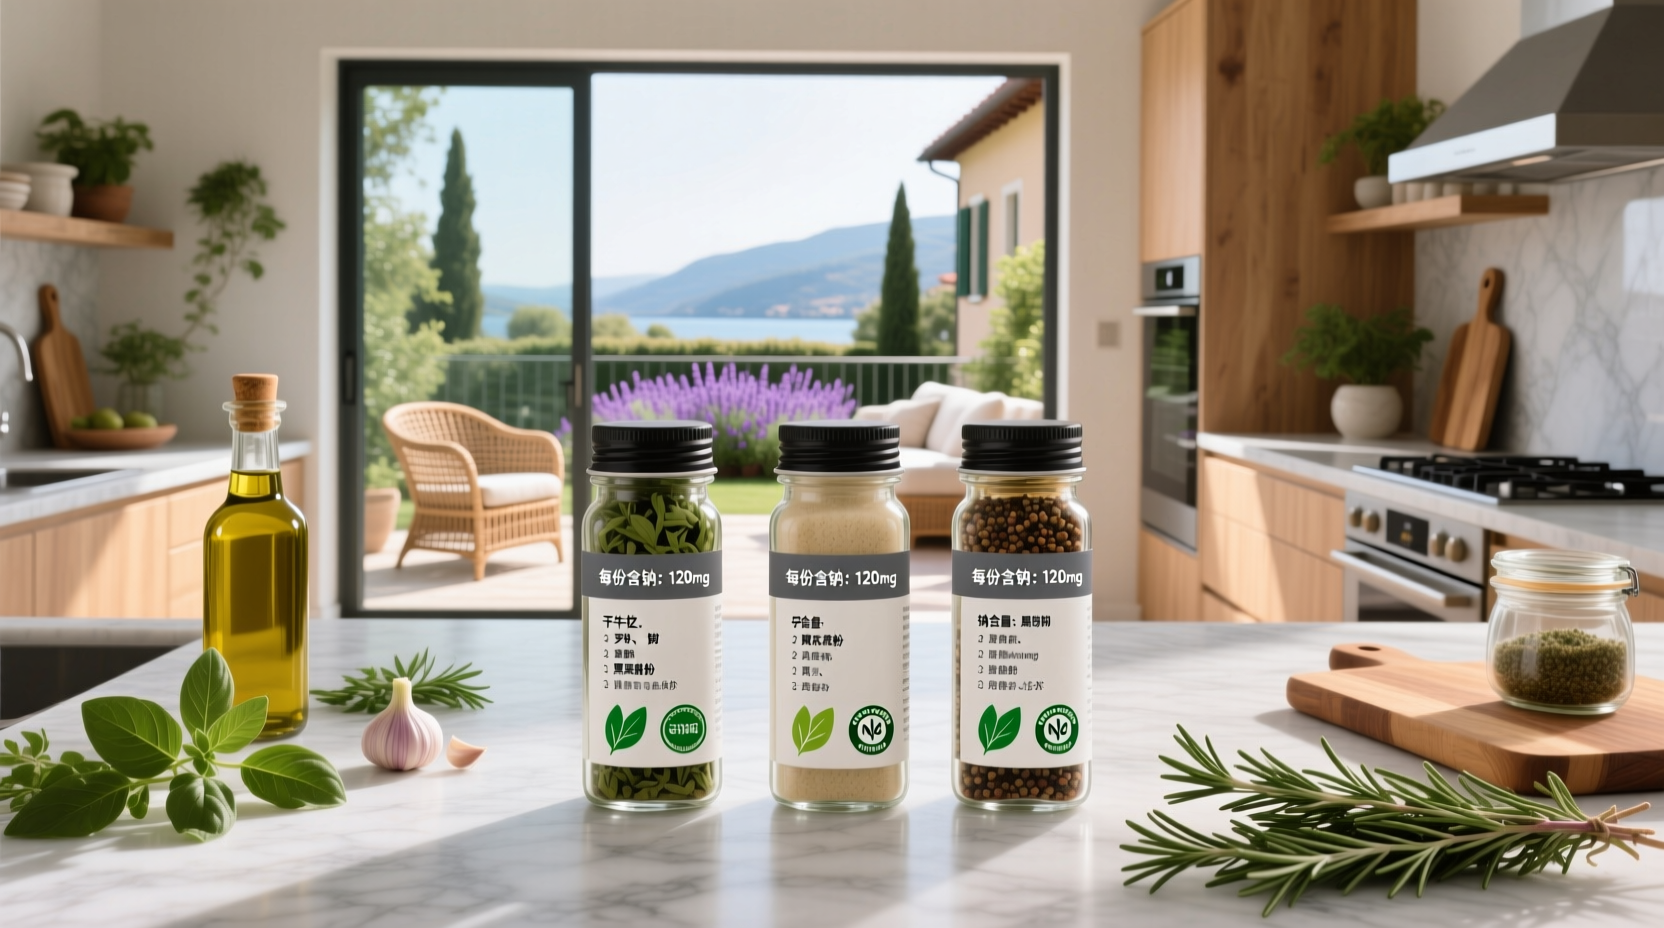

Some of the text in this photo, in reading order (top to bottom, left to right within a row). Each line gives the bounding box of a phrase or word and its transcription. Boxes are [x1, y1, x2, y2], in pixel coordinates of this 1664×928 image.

[669, 570, 710, 587] 120mg
[855, 570, 897, 588] 120mg
[1043, 569, 1083, 587] 120mg
